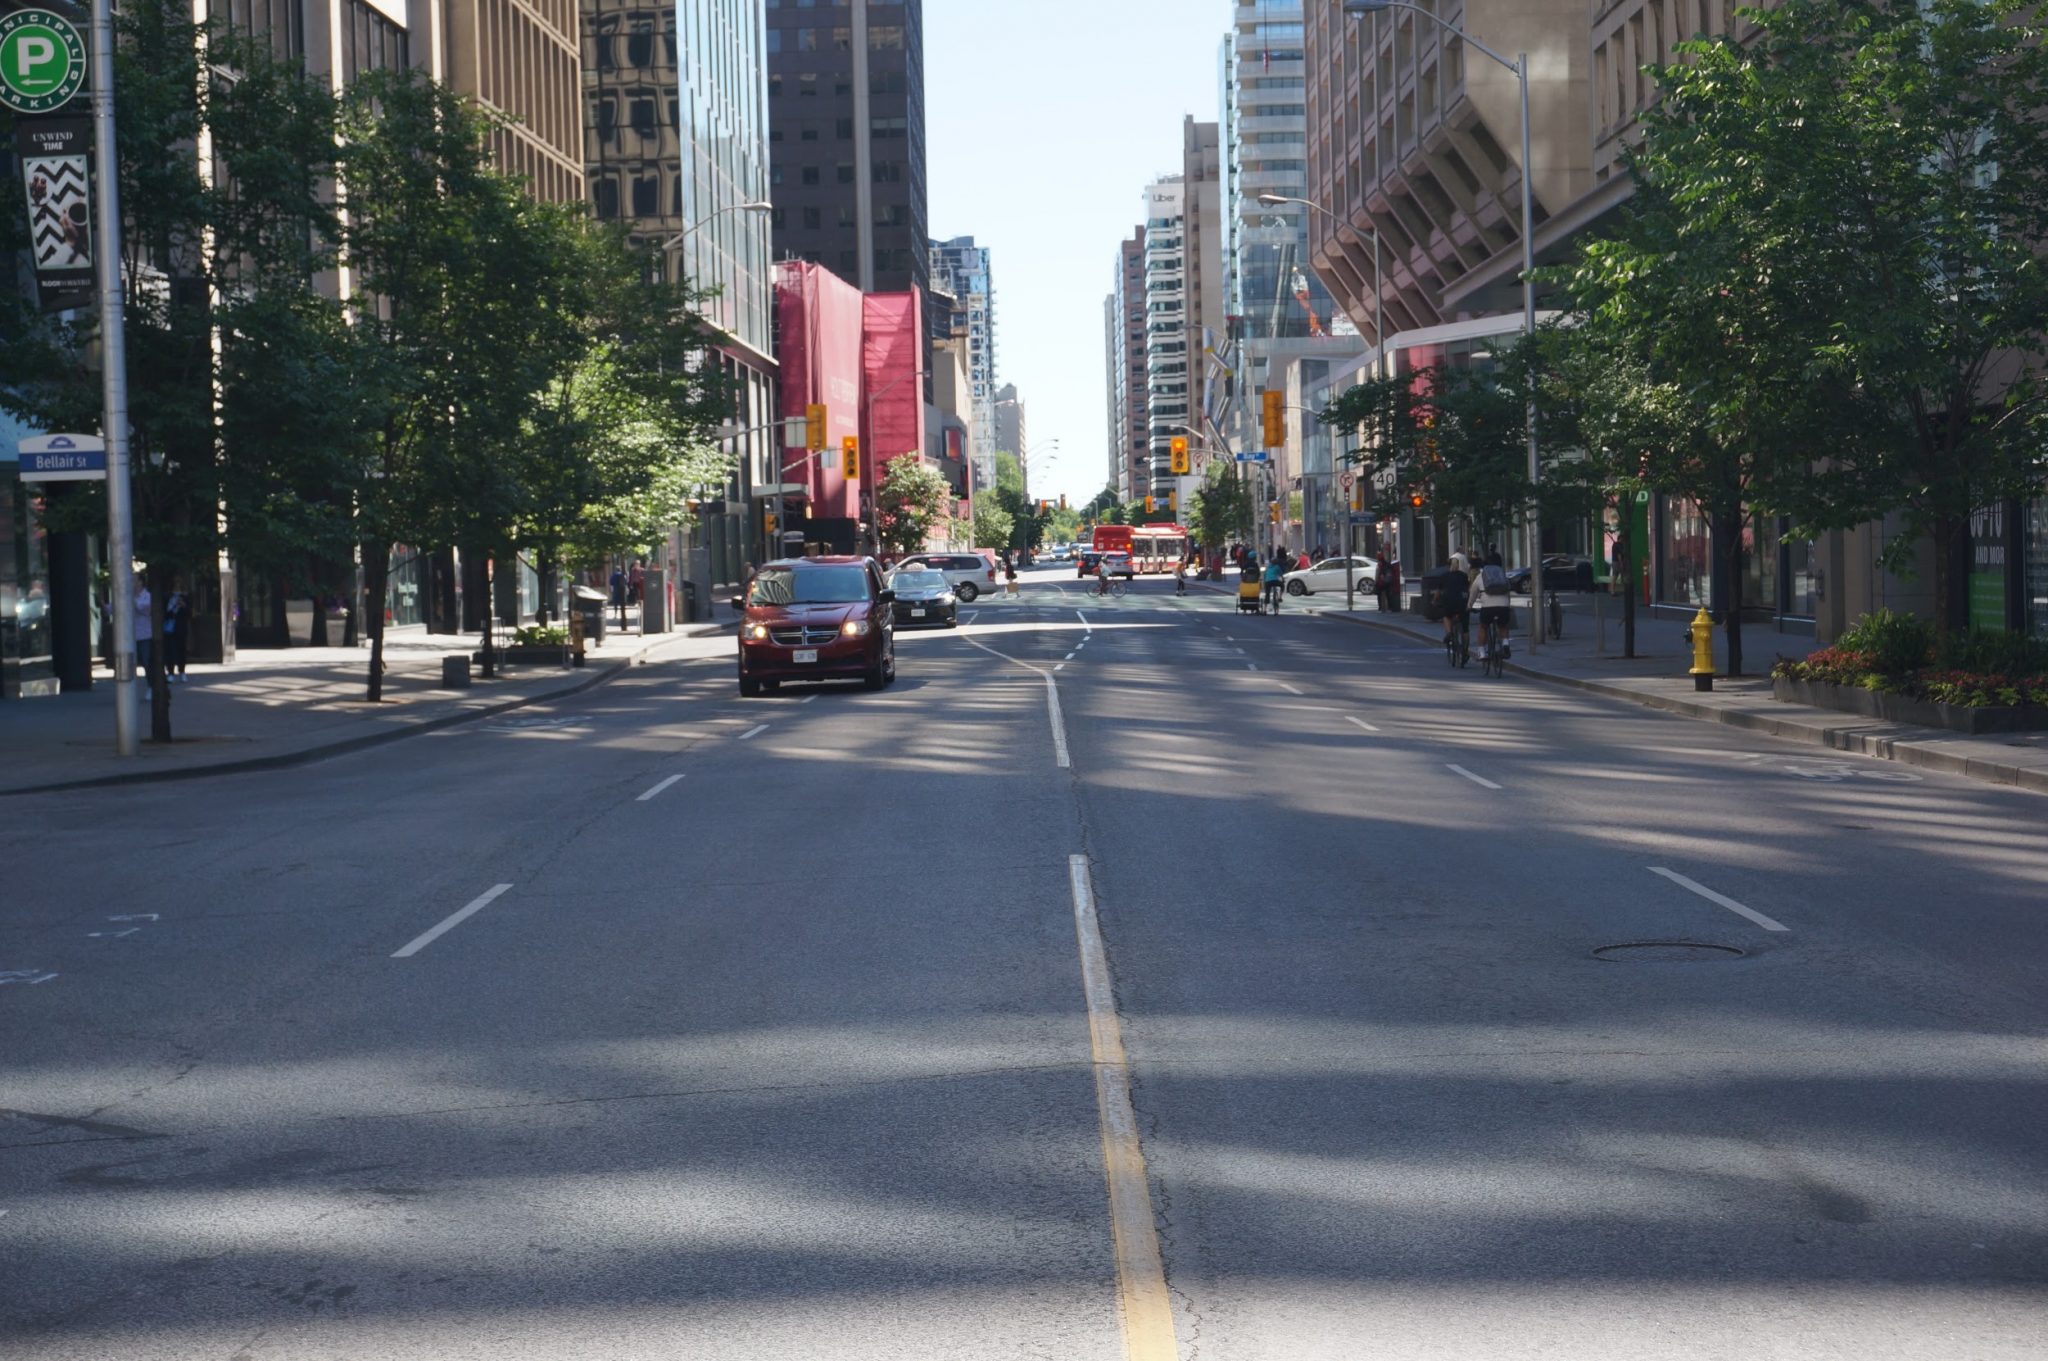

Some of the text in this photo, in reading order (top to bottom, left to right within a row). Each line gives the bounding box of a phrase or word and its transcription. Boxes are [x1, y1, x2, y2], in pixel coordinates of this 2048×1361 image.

[17, 36, 55, 76] P
[33, 131, 73, 142] UNWIND
[43, 141, 63, 151] TIME
[1152, 193, 1176, 202] Uber
[36, 454, 87, 470] Bellair St
[1376, 472, 1395, 486] 40
[1975, 546, 1989, 564] AND
